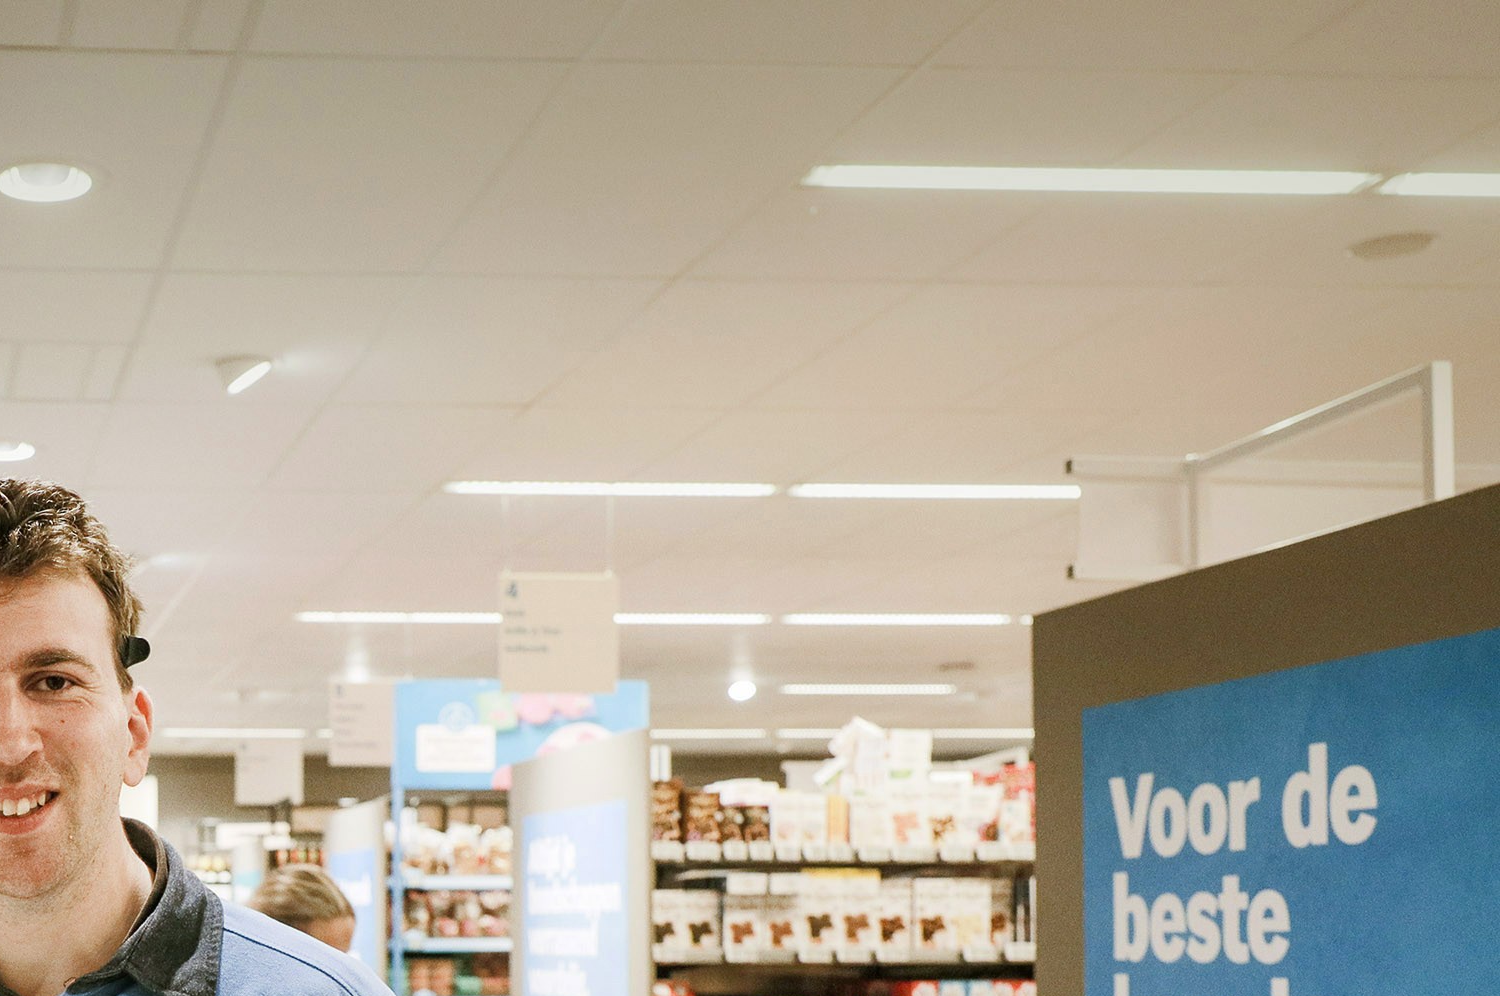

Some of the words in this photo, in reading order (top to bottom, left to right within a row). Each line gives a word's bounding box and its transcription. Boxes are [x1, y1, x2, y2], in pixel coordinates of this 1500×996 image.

[1108, 772, 1261, 859] Voor
[1281, 742, 1378, 848] de
[1112, 871, 1291, 965] beste
